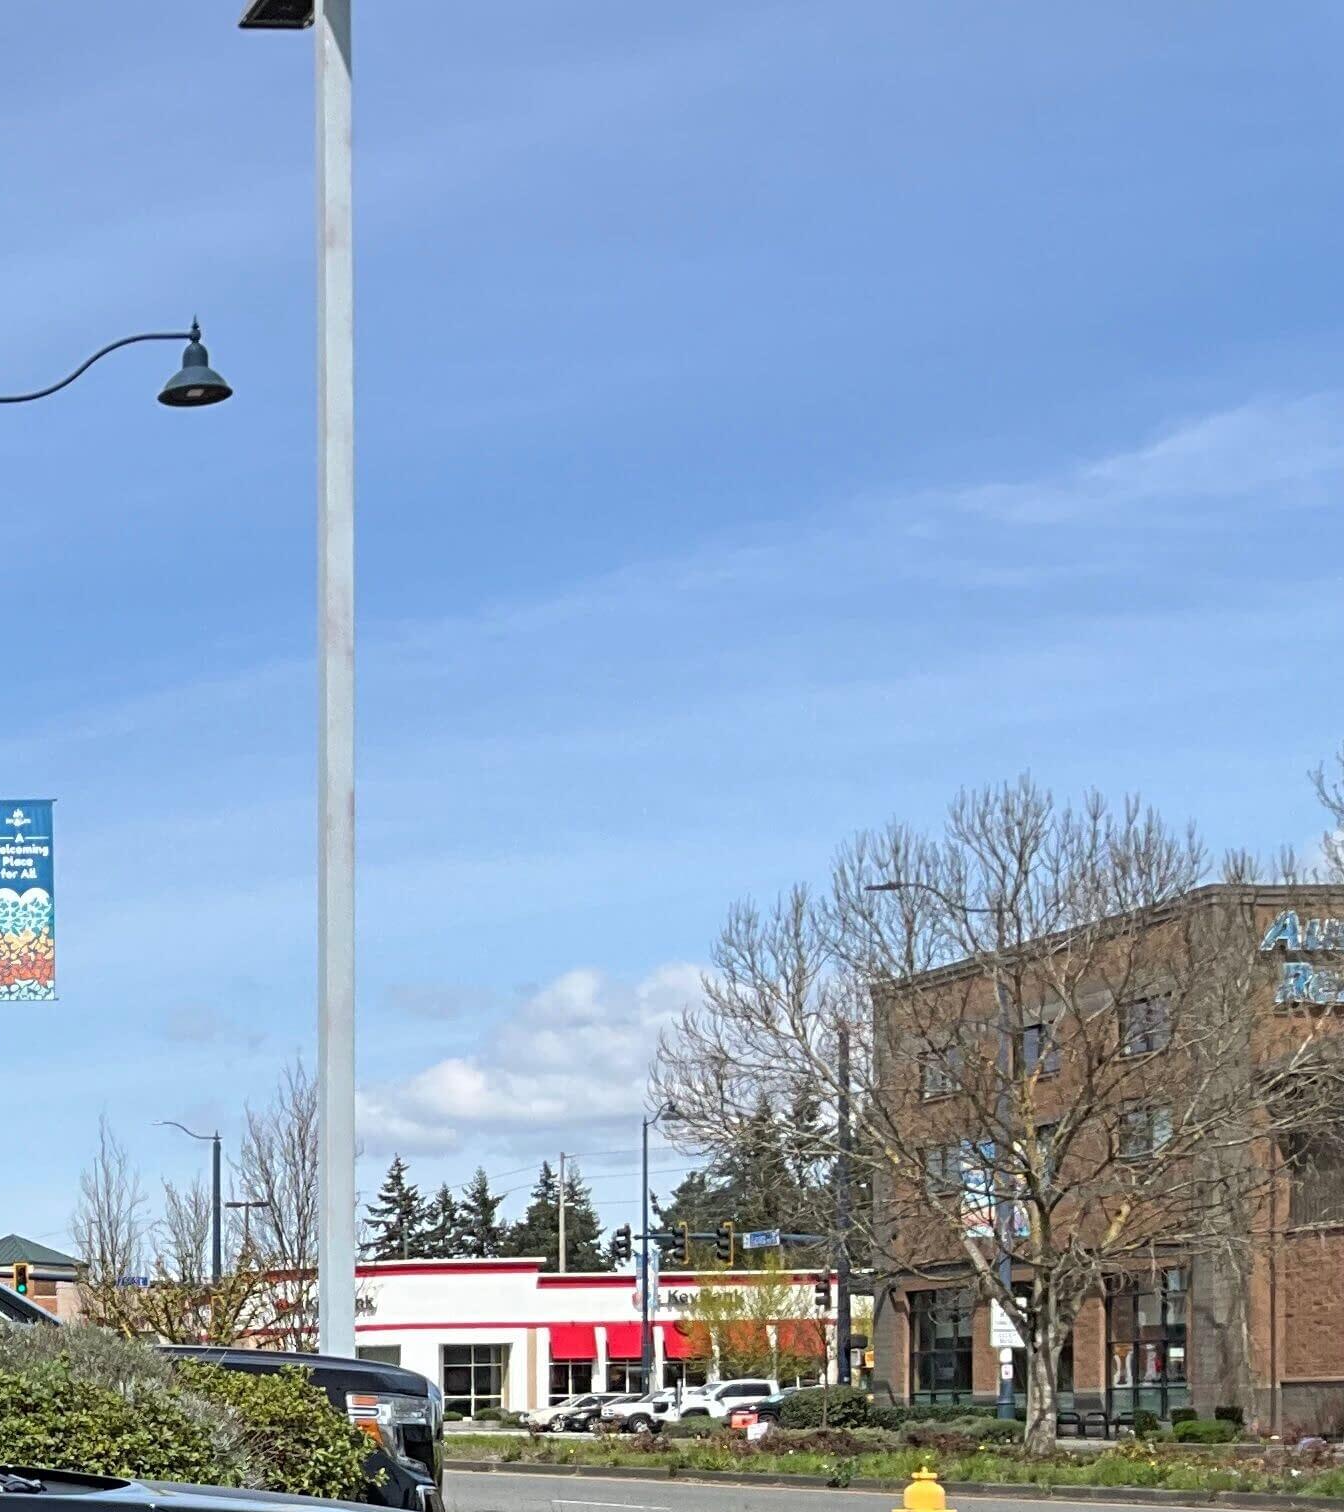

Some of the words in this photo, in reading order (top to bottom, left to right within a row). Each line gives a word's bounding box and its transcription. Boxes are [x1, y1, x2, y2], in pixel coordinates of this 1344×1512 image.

[14, 833, 25, 843] A
[2, 856, 33, 867] Place
[0, 868, 18, 879] for
